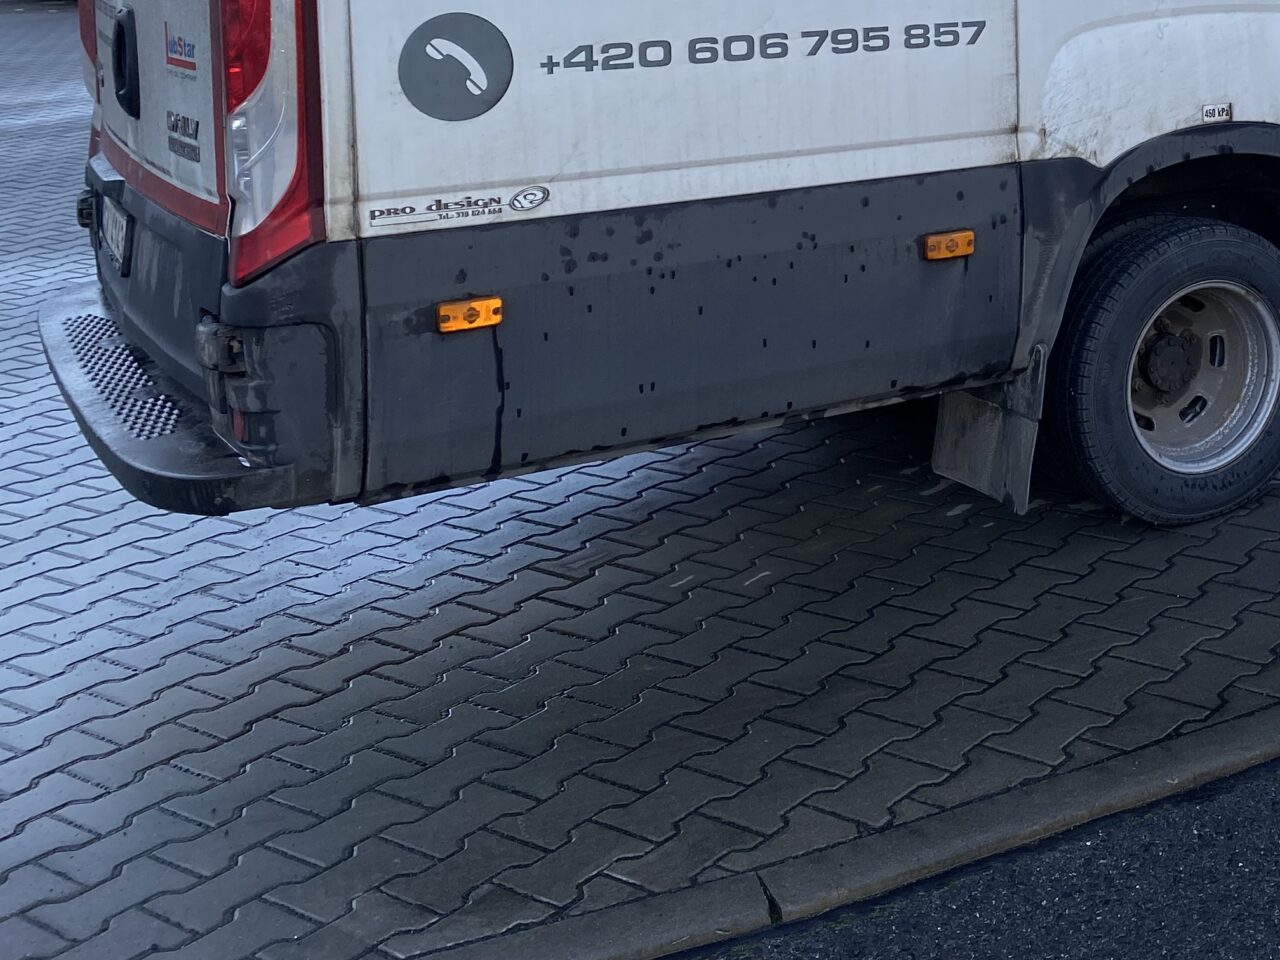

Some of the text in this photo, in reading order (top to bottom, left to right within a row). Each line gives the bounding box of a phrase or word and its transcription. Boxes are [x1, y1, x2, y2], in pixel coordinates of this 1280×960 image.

[540, 20, 987, 75] +420 606 795 857
[1204, 108, 1216, 118] 450
